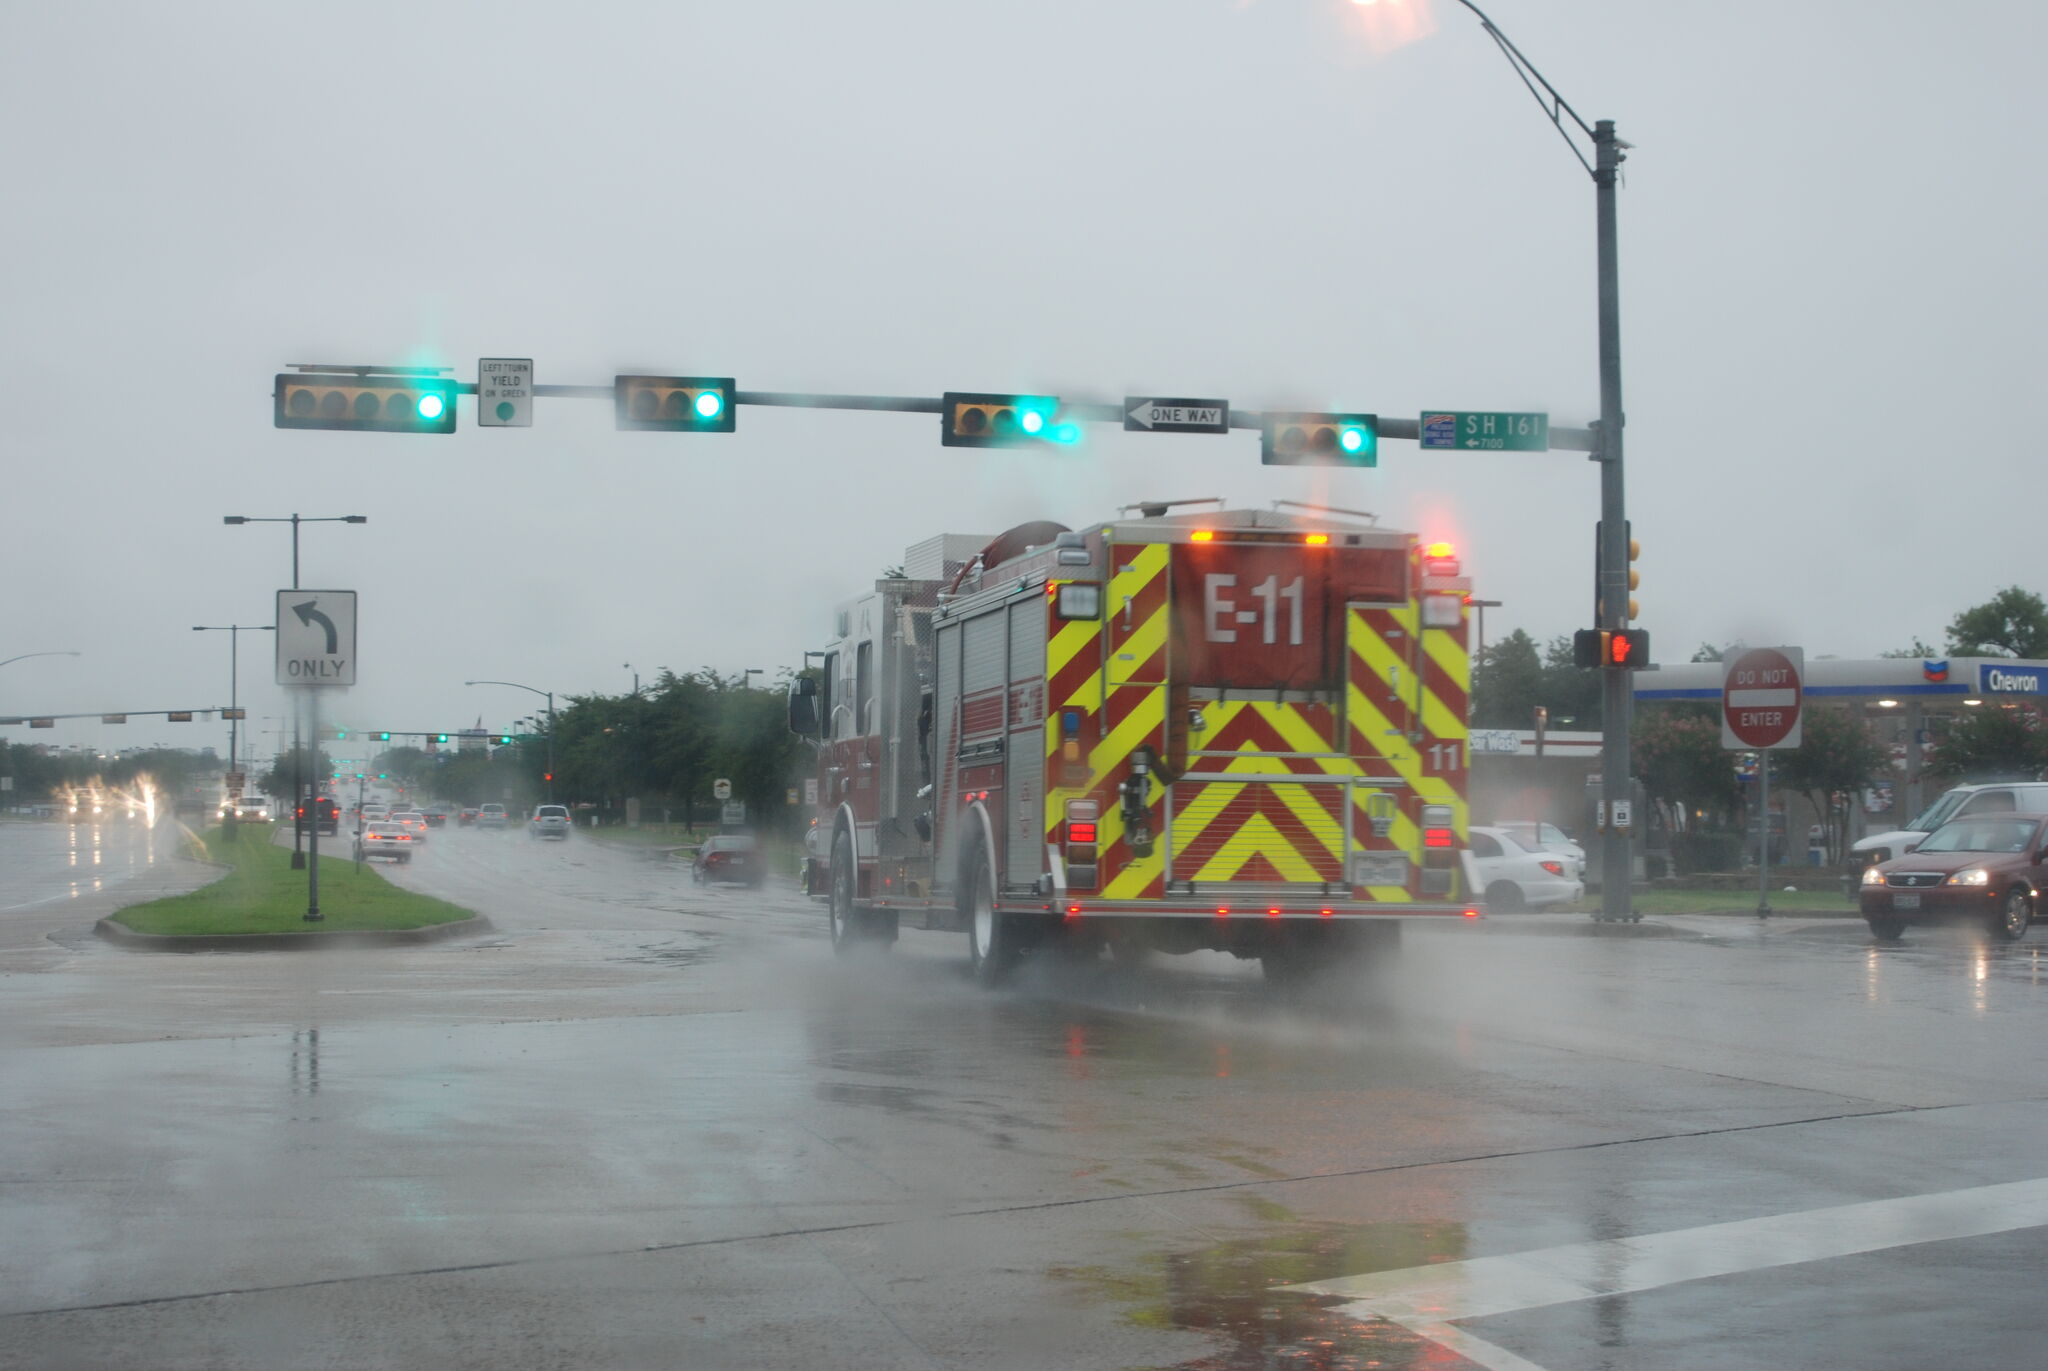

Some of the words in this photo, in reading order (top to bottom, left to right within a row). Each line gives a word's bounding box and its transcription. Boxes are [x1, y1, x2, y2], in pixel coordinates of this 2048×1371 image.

[483, 364, 501, 372] LEFT
[492, 376, 520, 386] YIELD
[1151, 409, 1181, 421] ONE
[1188, 410, 1217, 422] WAY
[1466, 416, 1495, 434] SH
[1507, 416, 1540, 435] 161
[1205, 573, 1304, 645] E-11
[288, 659, 345, 677] ONLY
[1737, 671, 1755, 684] DO
[1762, 669, 1788, 683] NOT
[1989, 669, 2038, 691] Chevron
[1741, 712, 1782, 726] ENTER
[1488, 731, 1519, 752] Wash
[1428, 743, 1458, 771] 11
